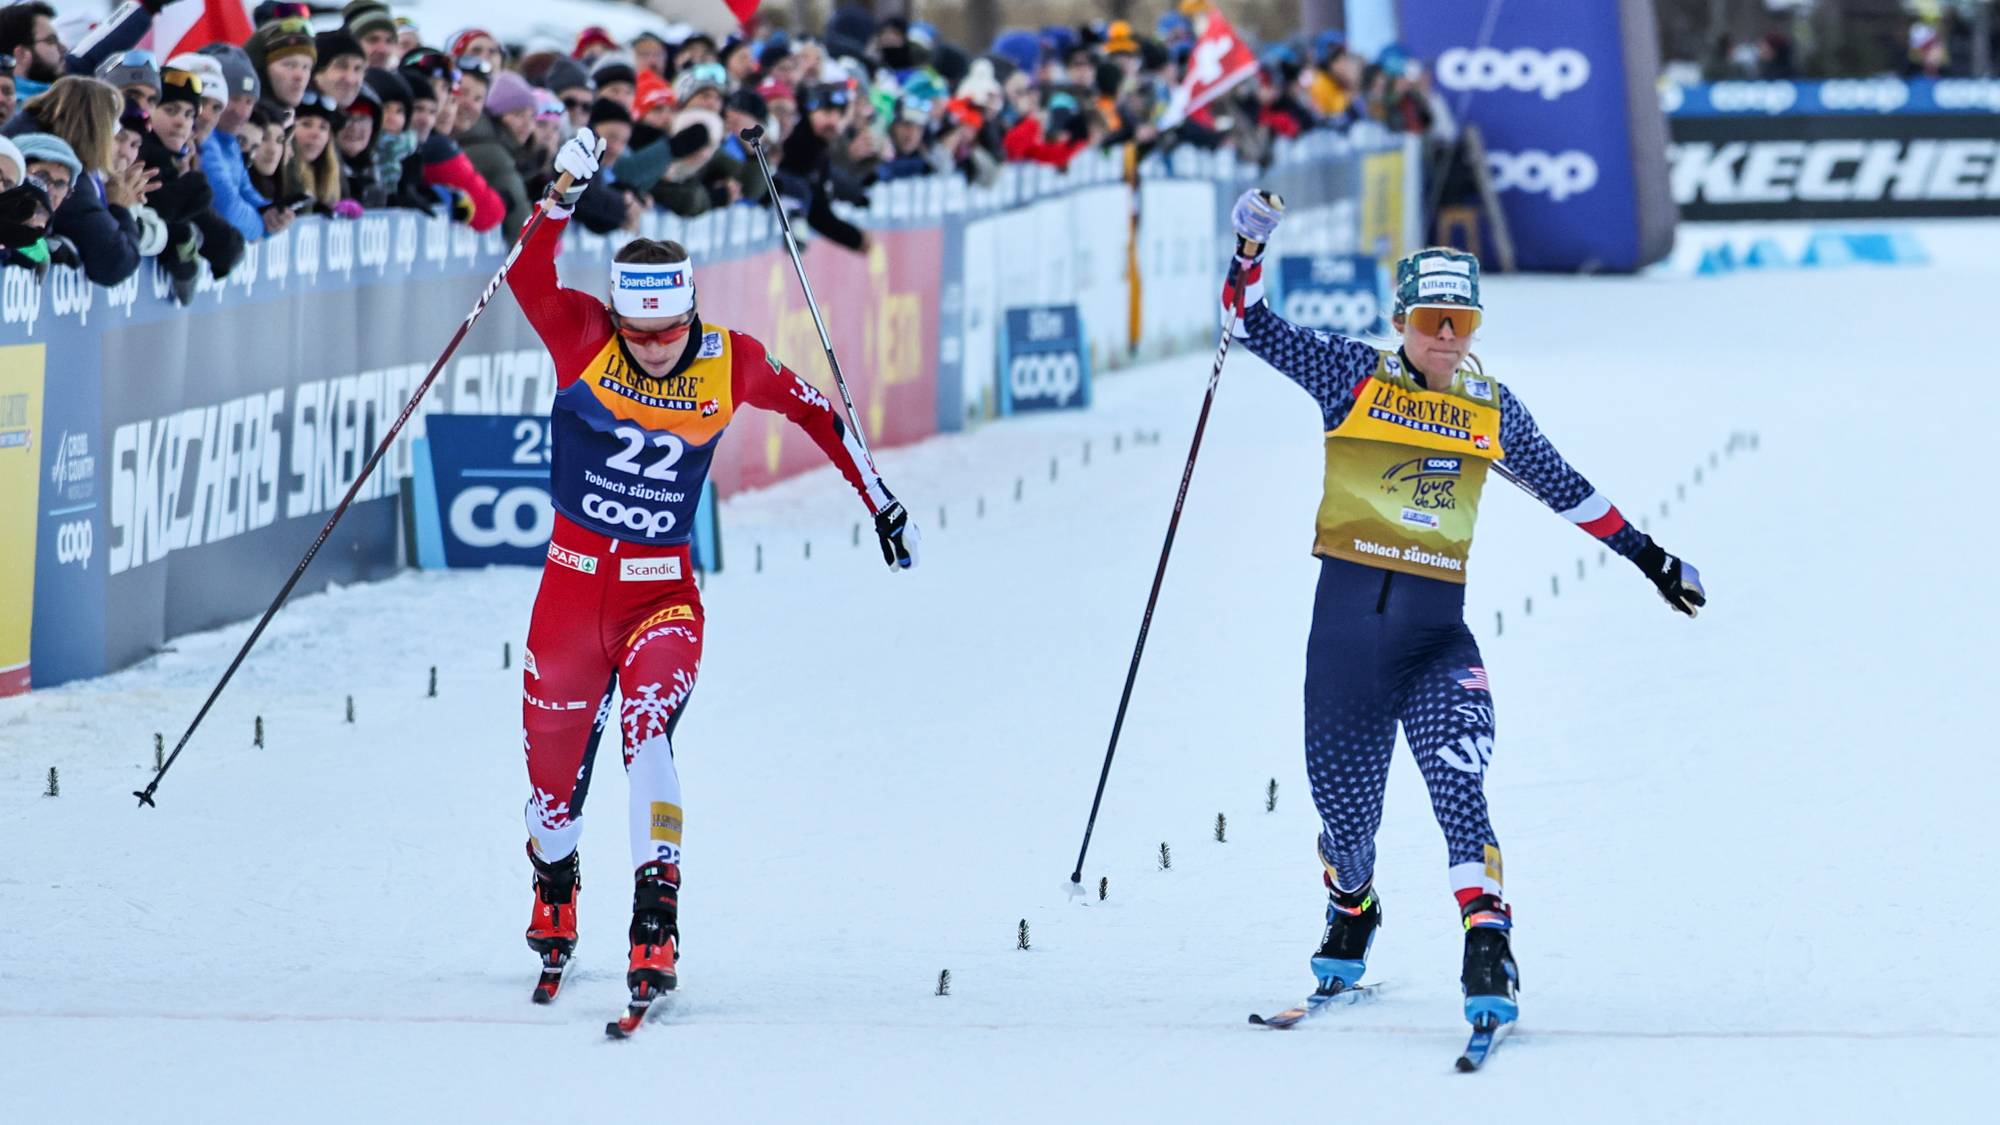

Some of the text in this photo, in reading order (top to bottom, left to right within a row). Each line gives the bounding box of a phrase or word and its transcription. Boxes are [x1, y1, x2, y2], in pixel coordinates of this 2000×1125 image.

[1435, 47, 1591, 100] coop
[1487, 149, 1599, 202] oop
[1666, 139, 2000, 204] KECHE
[620, 274, 673, 288] SpareBank
[674, 273, 682, 285] 1
[1421, 280, 1457, 289] Allianz
[604, 353, 624, 379] LE
[1011, 353, 1080, 407] coop
[603, 379, 692, 410] SWITZERLAND
[1372, 386, 1395, 409] LE
[512, 418, 553, 464] 2
[1372, 410, 1467, 439] SWITZERLAND
[605, 426, 684, 482] 22
[1427, 460, 1458, 470] coop
[109, 387, 285, 576] SKECHERS
[584, 470, 626, 495] Toblach
[582, 493, 677, 538] coop
[57, 518, 93, 570] coop
[1353, 538, 1400, 559] Toblach
[626, 564, 676, 576] Scandic
[624, 626, 685, 667] CRAFT
